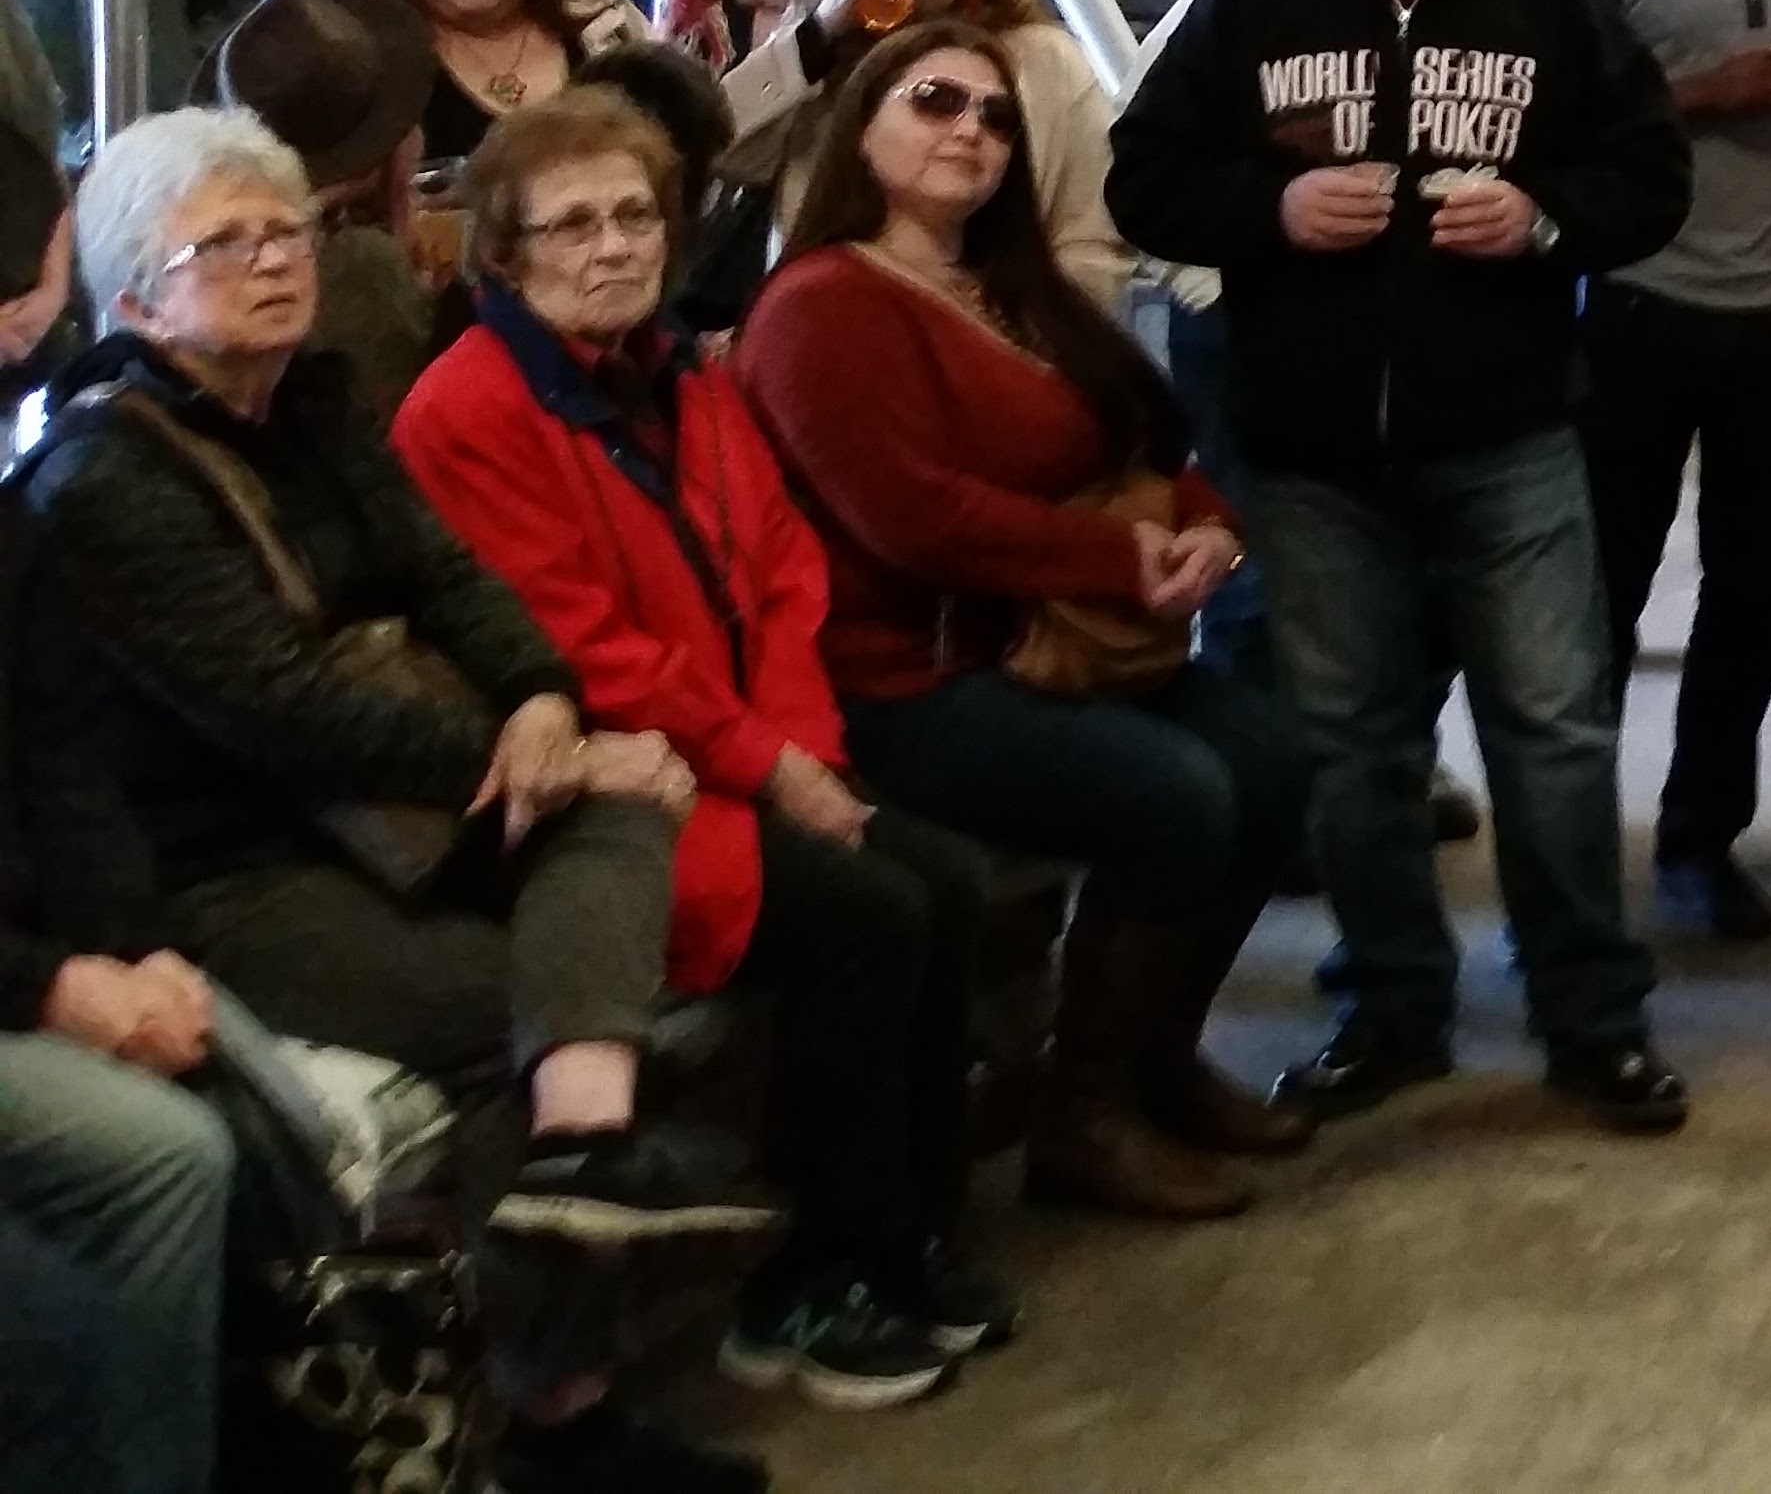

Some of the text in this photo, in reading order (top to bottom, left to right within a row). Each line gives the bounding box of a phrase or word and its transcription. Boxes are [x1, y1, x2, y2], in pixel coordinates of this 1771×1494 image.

[1411, 46, 1537, 110] SERIES
[1331, 98, 1523, 162] OF POKER
